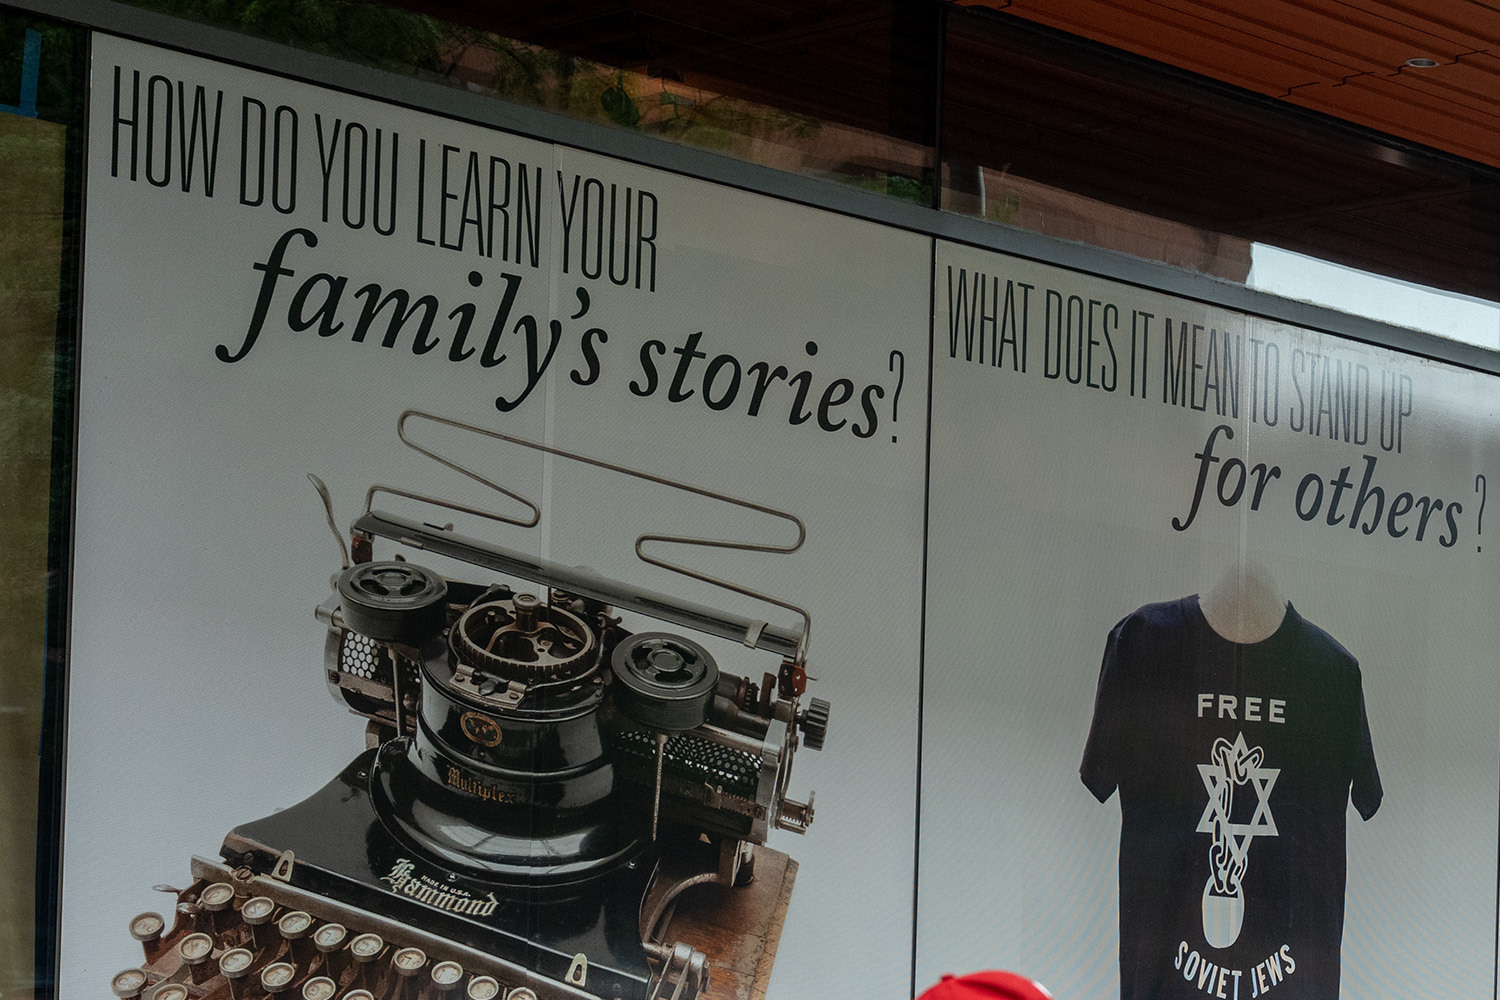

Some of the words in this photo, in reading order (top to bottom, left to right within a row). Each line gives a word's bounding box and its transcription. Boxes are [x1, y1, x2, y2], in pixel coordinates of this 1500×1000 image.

[111, 65, 223, 198] HOW
[239, 96, 299, 215] DO
[315, 113, 399, 237] YOU
[416, 138, 542, 269] LEARN
[557, 169, 658, 293] YOUR
[215, 227, 607, 412] family's
[628, 329, 905, 444] stories?
[947, 266, 1035, 373] WHAT
[1044, 289, 1119, 393] DOES
[1129, 309, 1155, 399] IT
[1163, 317, 1240, 419] MEAN
[1249, 337, 1280, 428] TO
[1290, 348, 1369, 447] STAND
[1380, 369, 1413, 454] UP
[1172, 425, 1282, 532] for
[1197, 693, 1287, 724] FREE
[447, 764, 516, 804] Multiplex
[380, 857, 500, 916] Hammond
[421, 875, 439, 887] MADE
[450, 888, 471, 897] U.S.A.
[1174, 940, 1242, 1000] SOVIET
[1251, 944, 1296, 1000] JEWS
